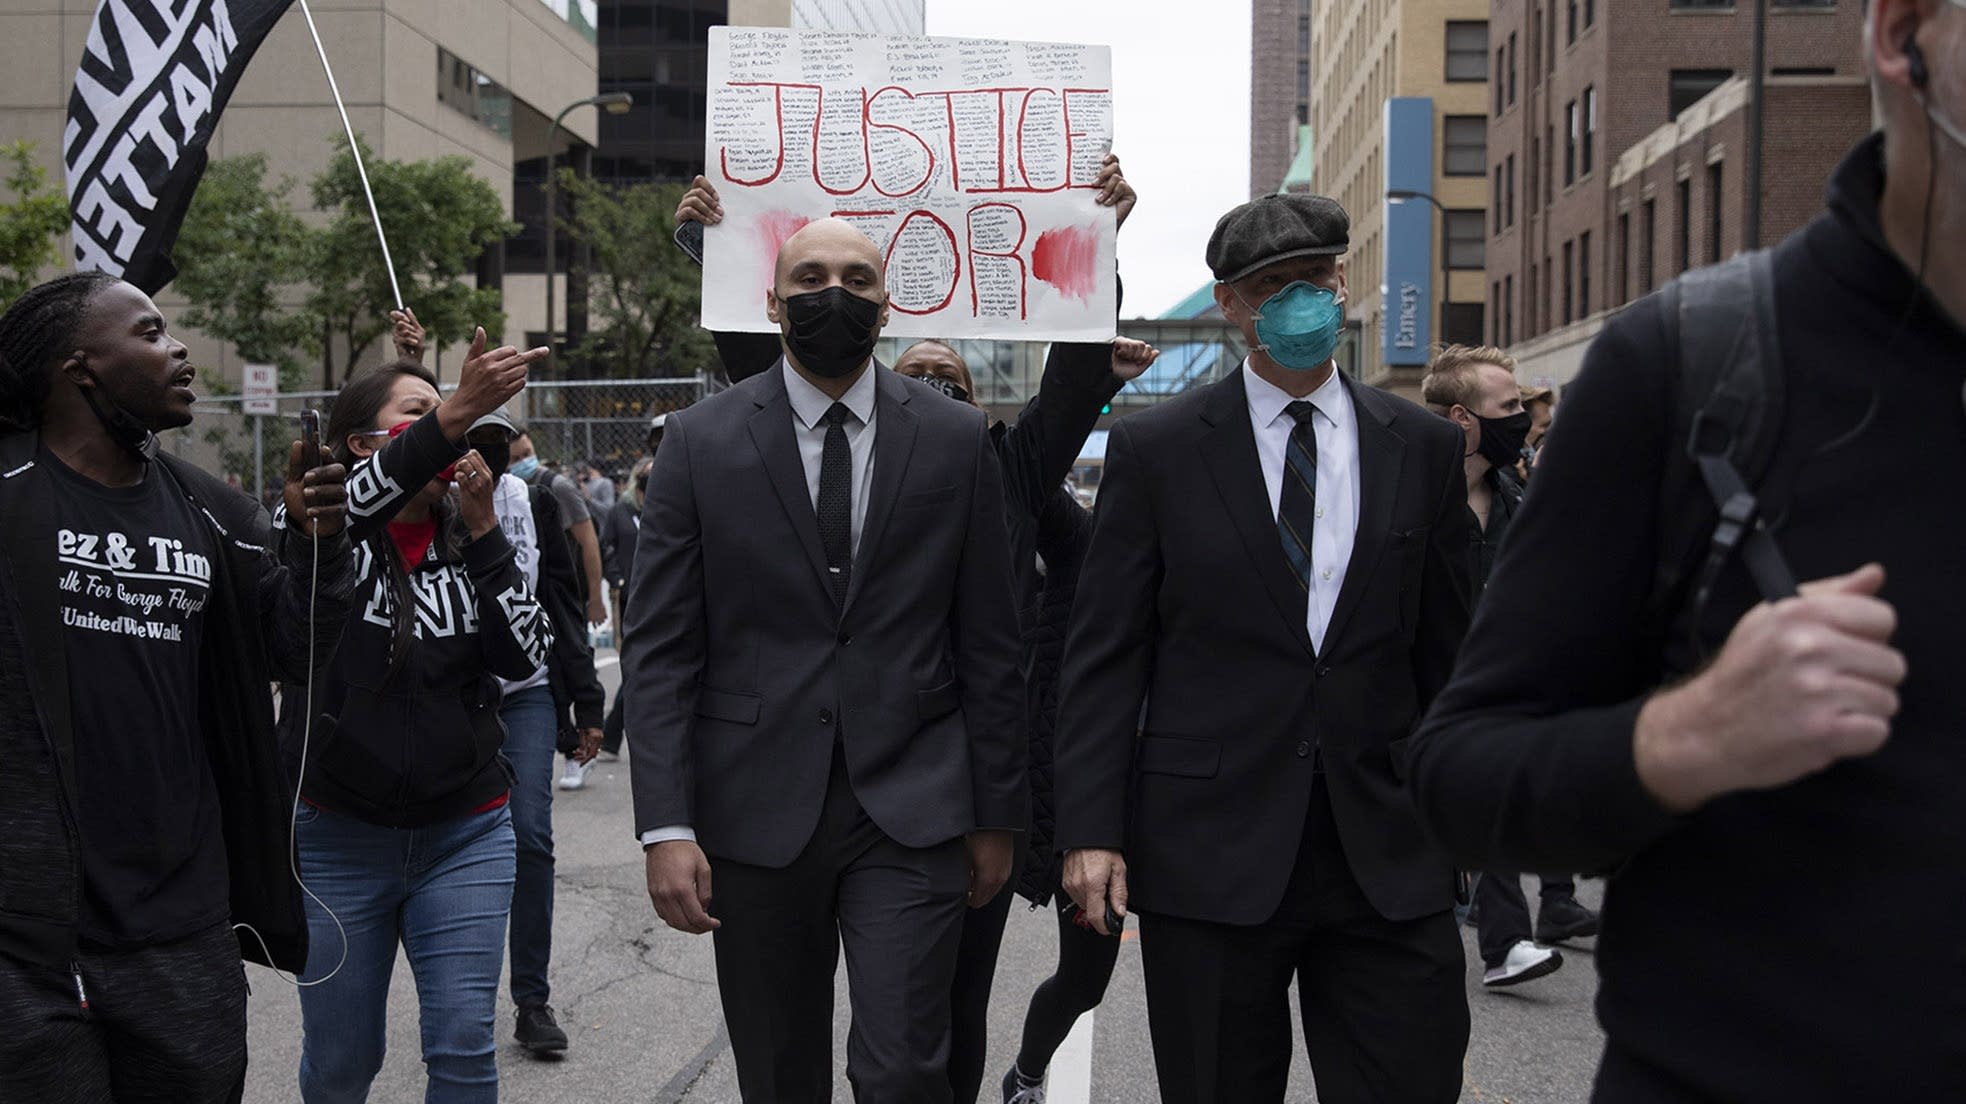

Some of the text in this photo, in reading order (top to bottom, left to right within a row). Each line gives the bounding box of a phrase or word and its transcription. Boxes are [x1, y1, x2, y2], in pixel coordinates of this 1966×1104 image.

[721, 79, 1110, 198] JUSTICE
[1395, 281, 1422, 351] Emery
[105, 532, 137, 571] &
[86, 573, 113, 600] For
[117, 583, 163, 616] George
[169, 587, 206, 619] Floyd
[60, 607, 183, 642] UnitedWeWalk
